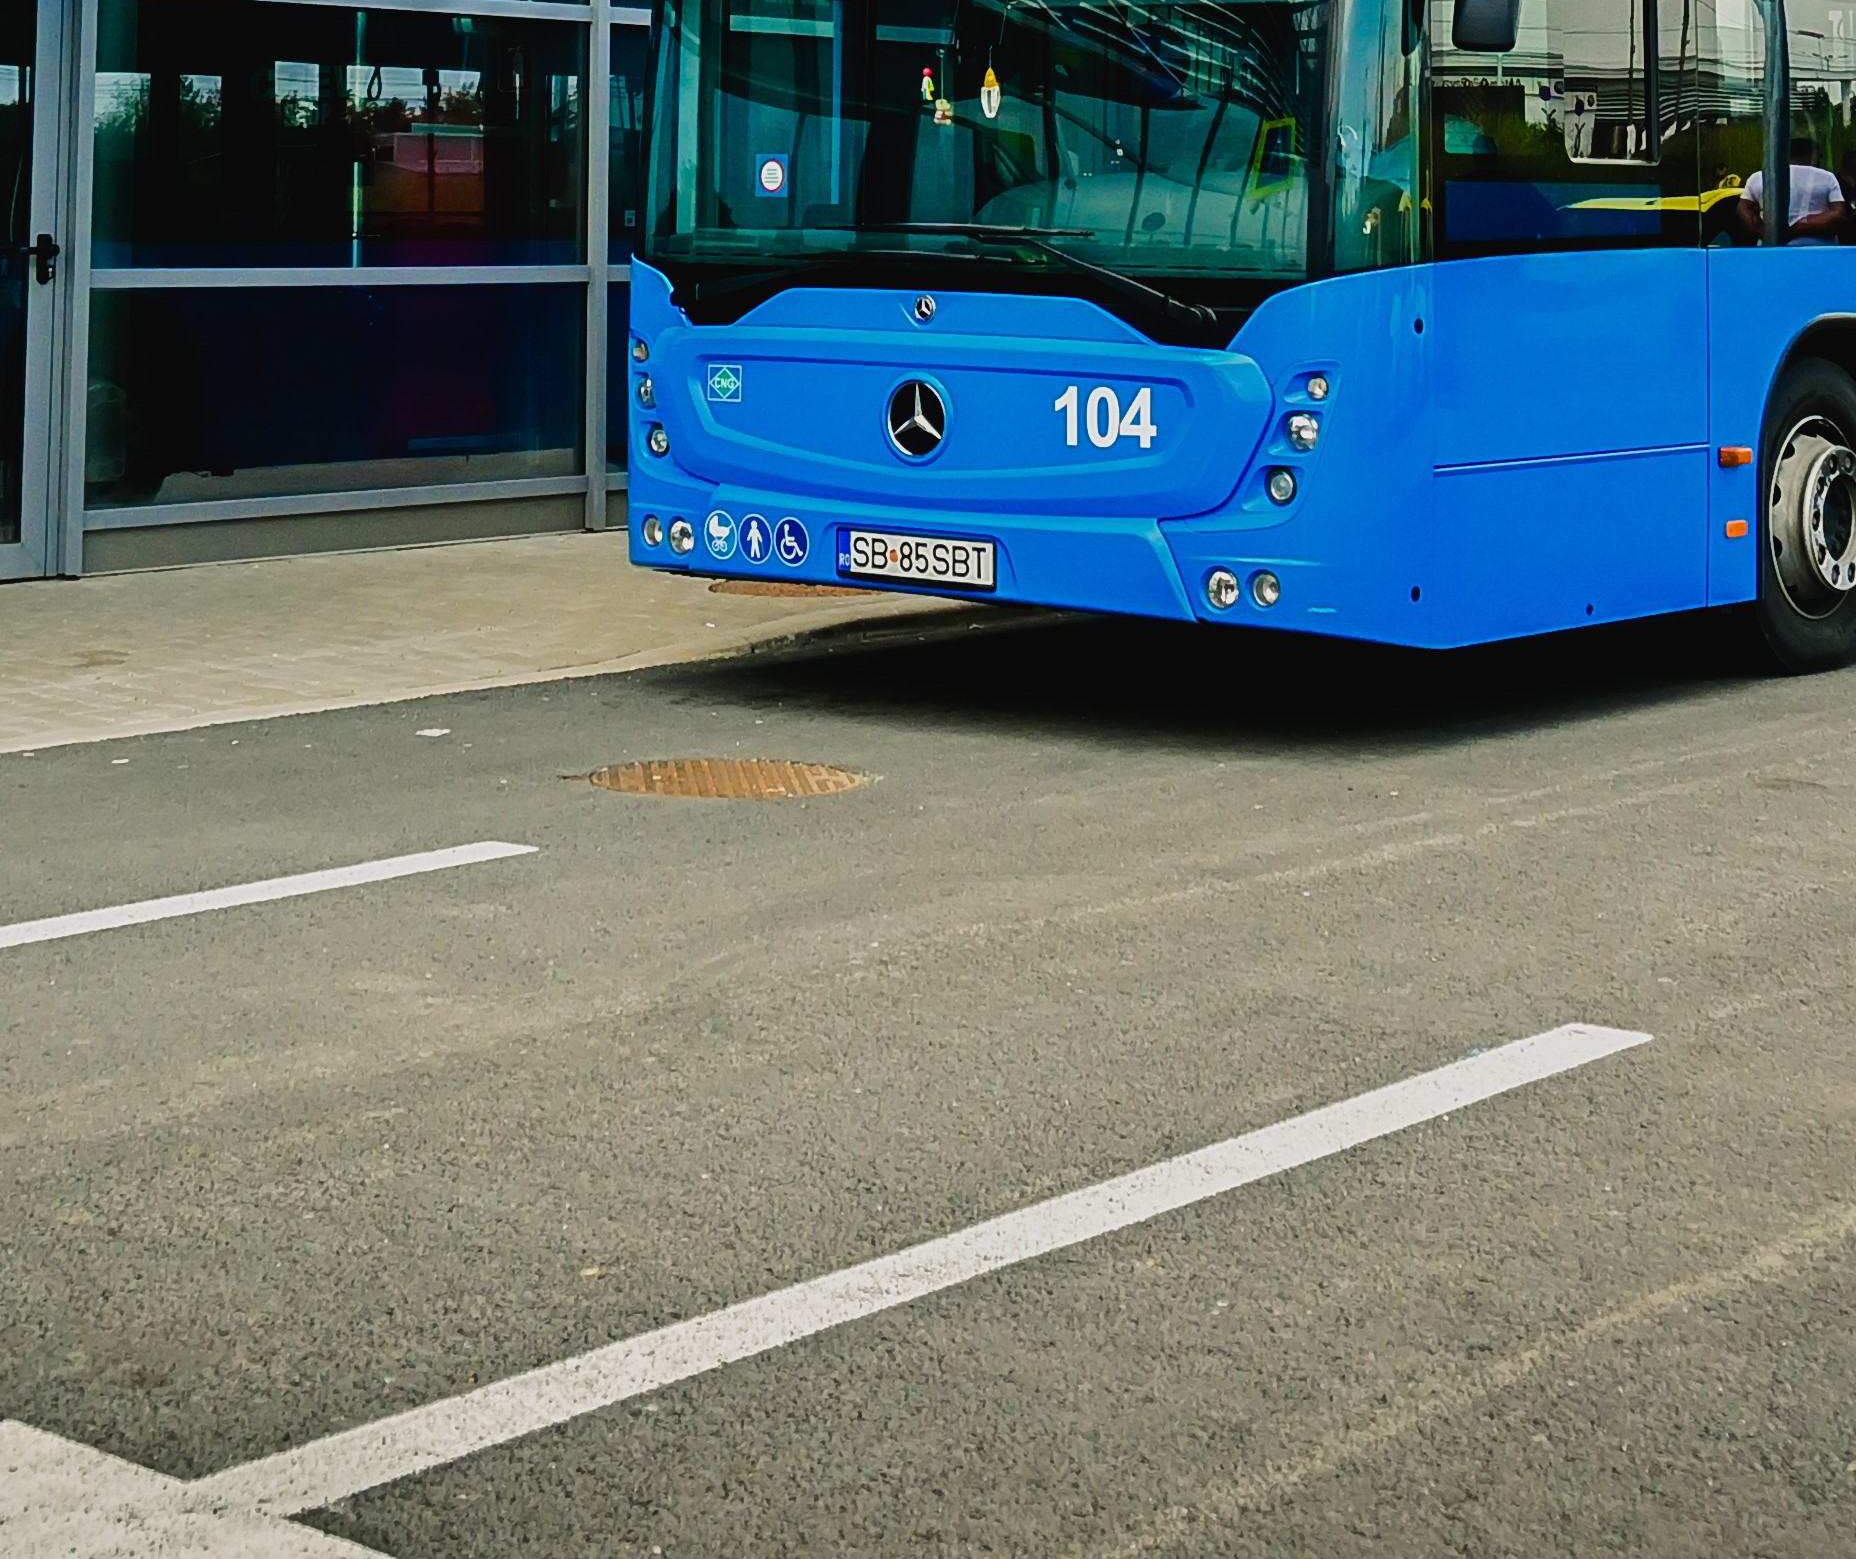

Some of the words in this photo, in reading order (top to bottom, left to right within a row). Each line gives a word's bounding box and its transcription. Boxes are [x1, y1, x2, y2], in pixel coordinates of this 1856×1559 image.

[714, 377, 735, 390] CNG
[1054, 385, 1157, 449] 104
[839, 553, 850, 567] RO
